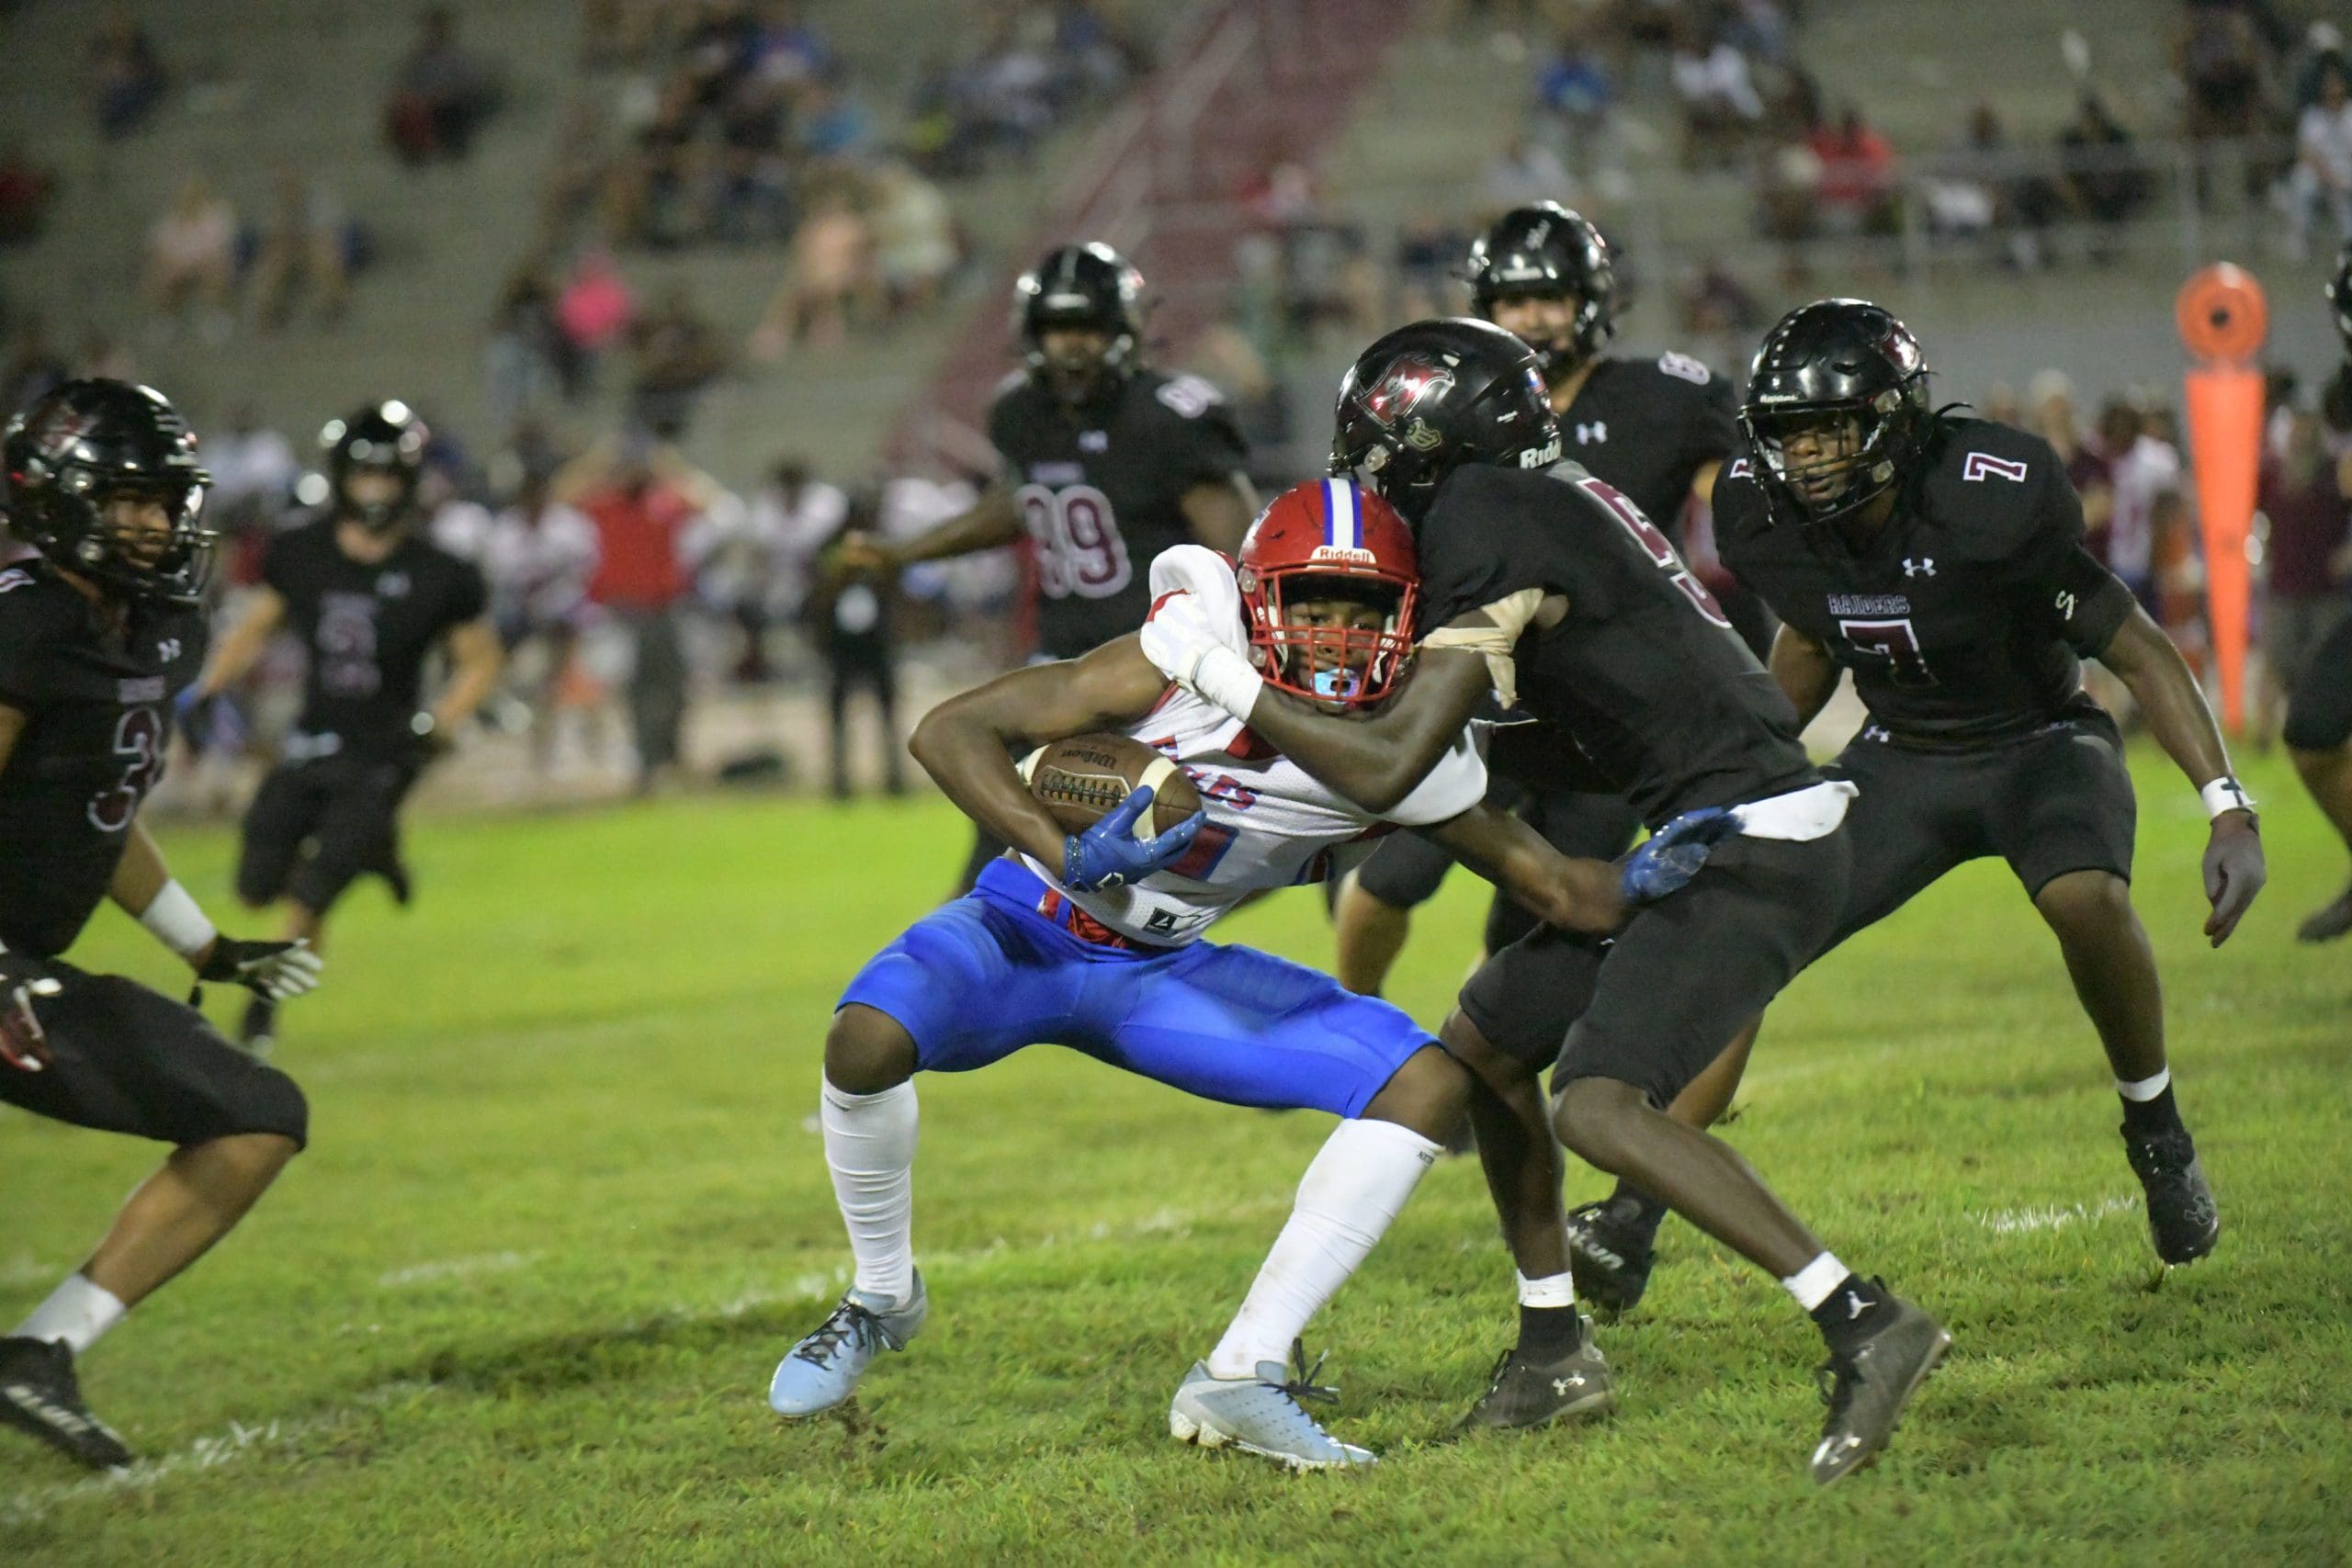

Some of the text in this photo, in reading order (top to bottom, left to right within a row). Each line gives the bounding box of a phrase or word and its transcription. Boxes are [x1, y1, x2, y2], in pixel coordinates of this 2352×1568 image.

[1962, 452, 2028, 483] 7
[1319, 547, 1370, 562] Riddell
[1827, 593, 1911, 615] RAIDERS
[1839, 618, 1937, 686] 7
[1060, 750, 1117, 770] Wilson
